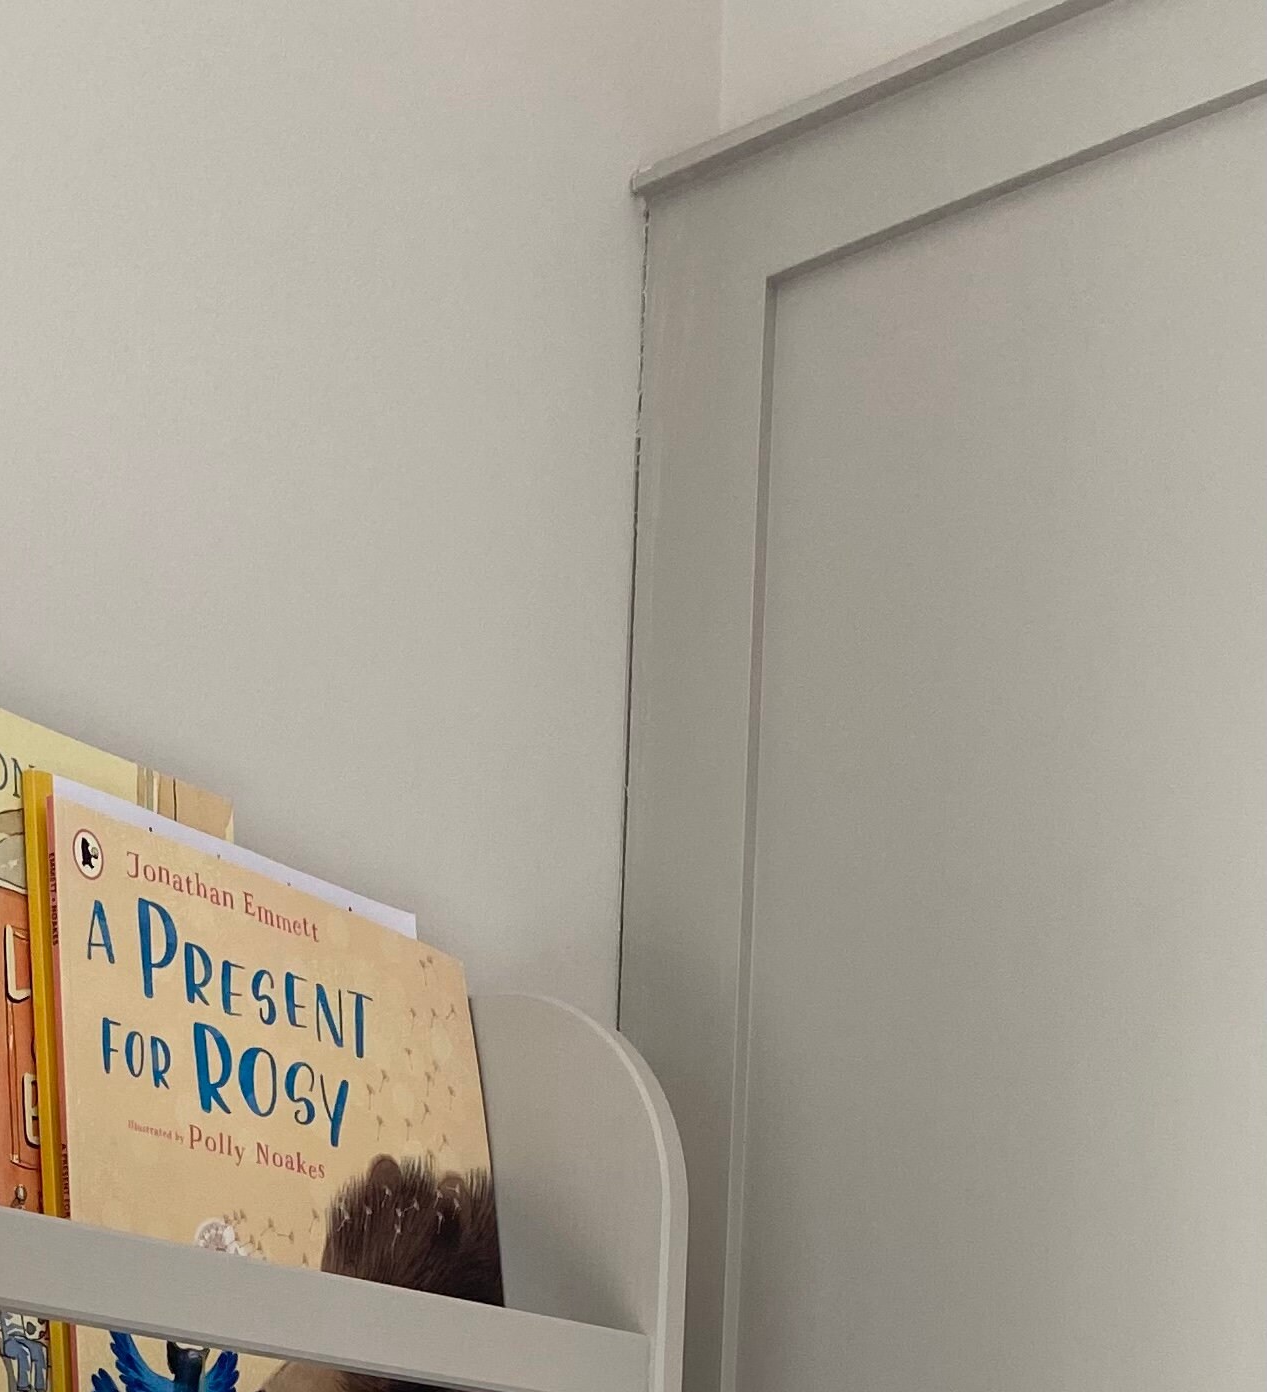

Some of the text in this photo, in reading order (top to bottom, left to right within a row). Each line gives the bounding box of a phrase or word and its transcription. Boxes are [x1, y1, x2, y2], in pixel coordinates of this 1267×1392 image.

[49, 852, 57, 893] EMMETT
[126, 850, 320, 943] Jonathan Emmett
[86, 897, 374, 1060] A PRESENT
[102, 1017, 350, 1148] FOR ROSY
[175, 1130, 185, 1144] by
[189, 1124, 246, 1167] Polly
[255, 1141, 326, 1180] Noakes
